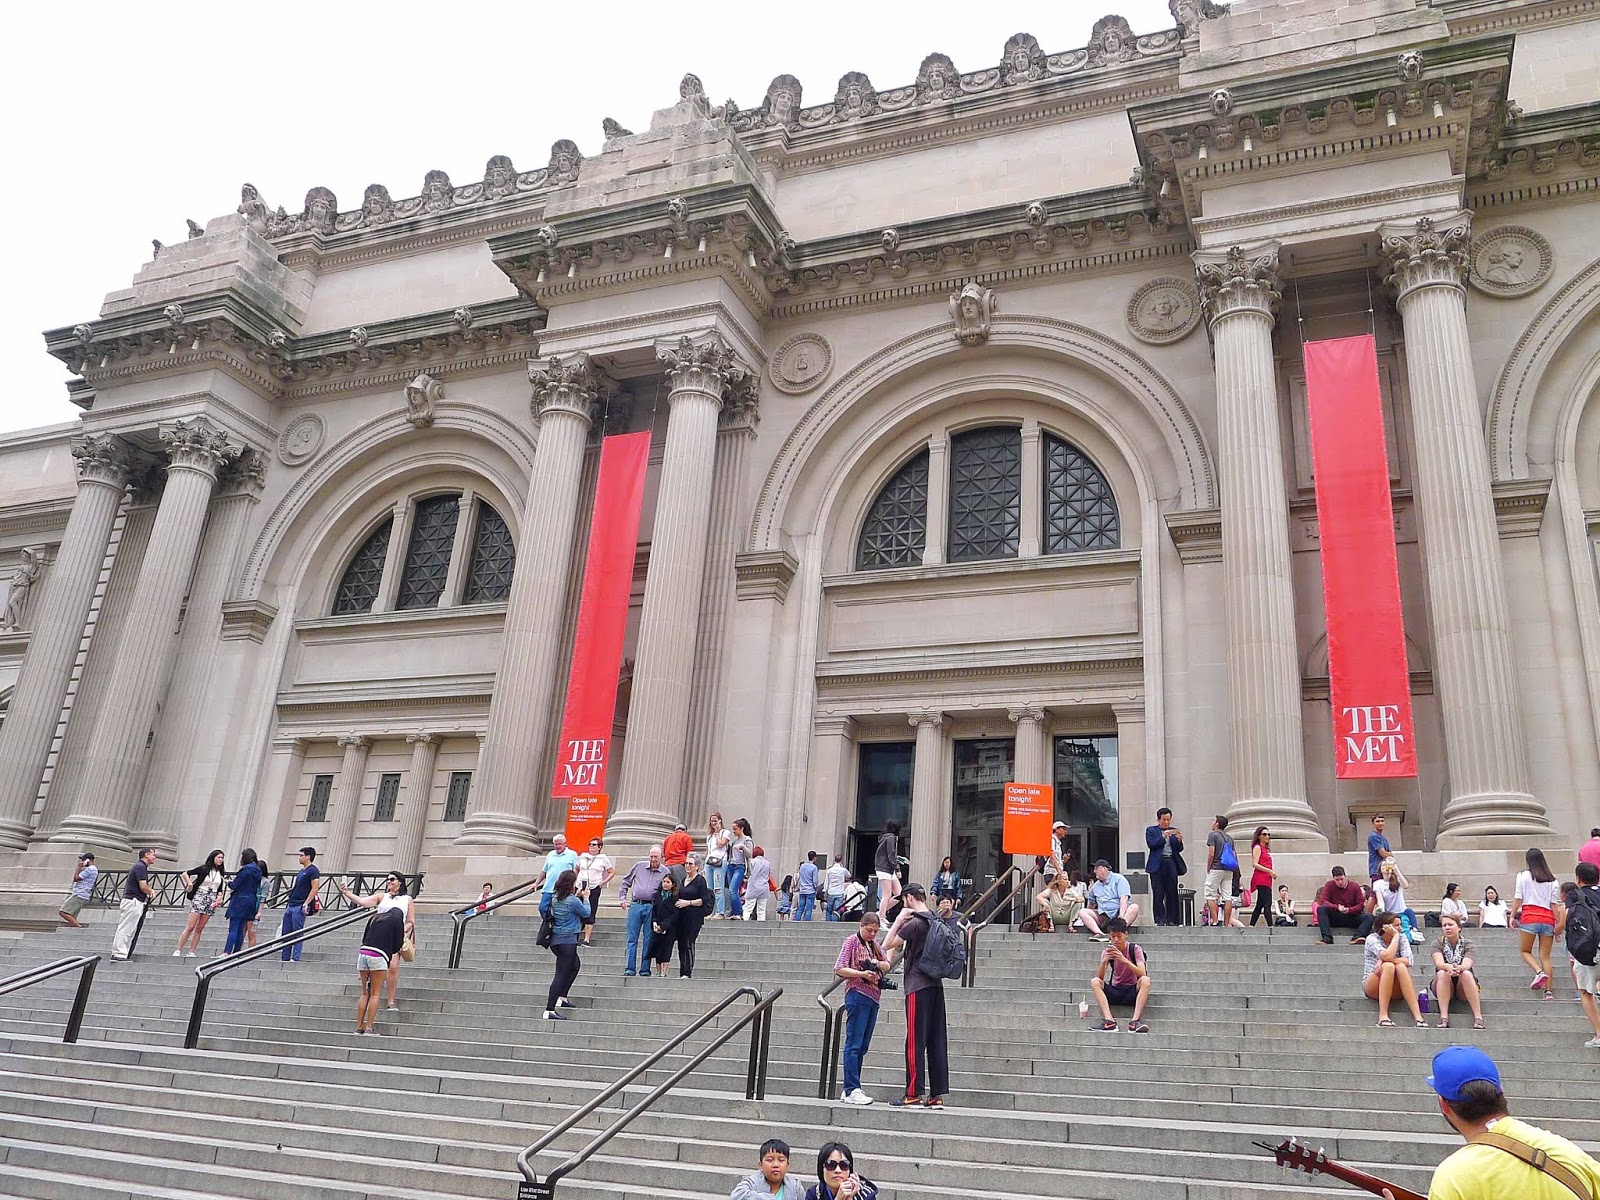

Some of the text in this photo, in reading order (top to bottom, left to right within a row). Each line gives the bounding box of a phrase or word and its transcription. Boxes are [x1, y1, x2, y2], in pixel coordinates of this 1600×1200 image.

[1343, 705, 1401, 734] THE
[568, 739, 604, 762] THE
[1343, 735, 1405, 763] MET
[560, 763, 603, 786] MET
[1008, 787, 1027, 795] Open
[1008, 796, 1032, 804] tonight
